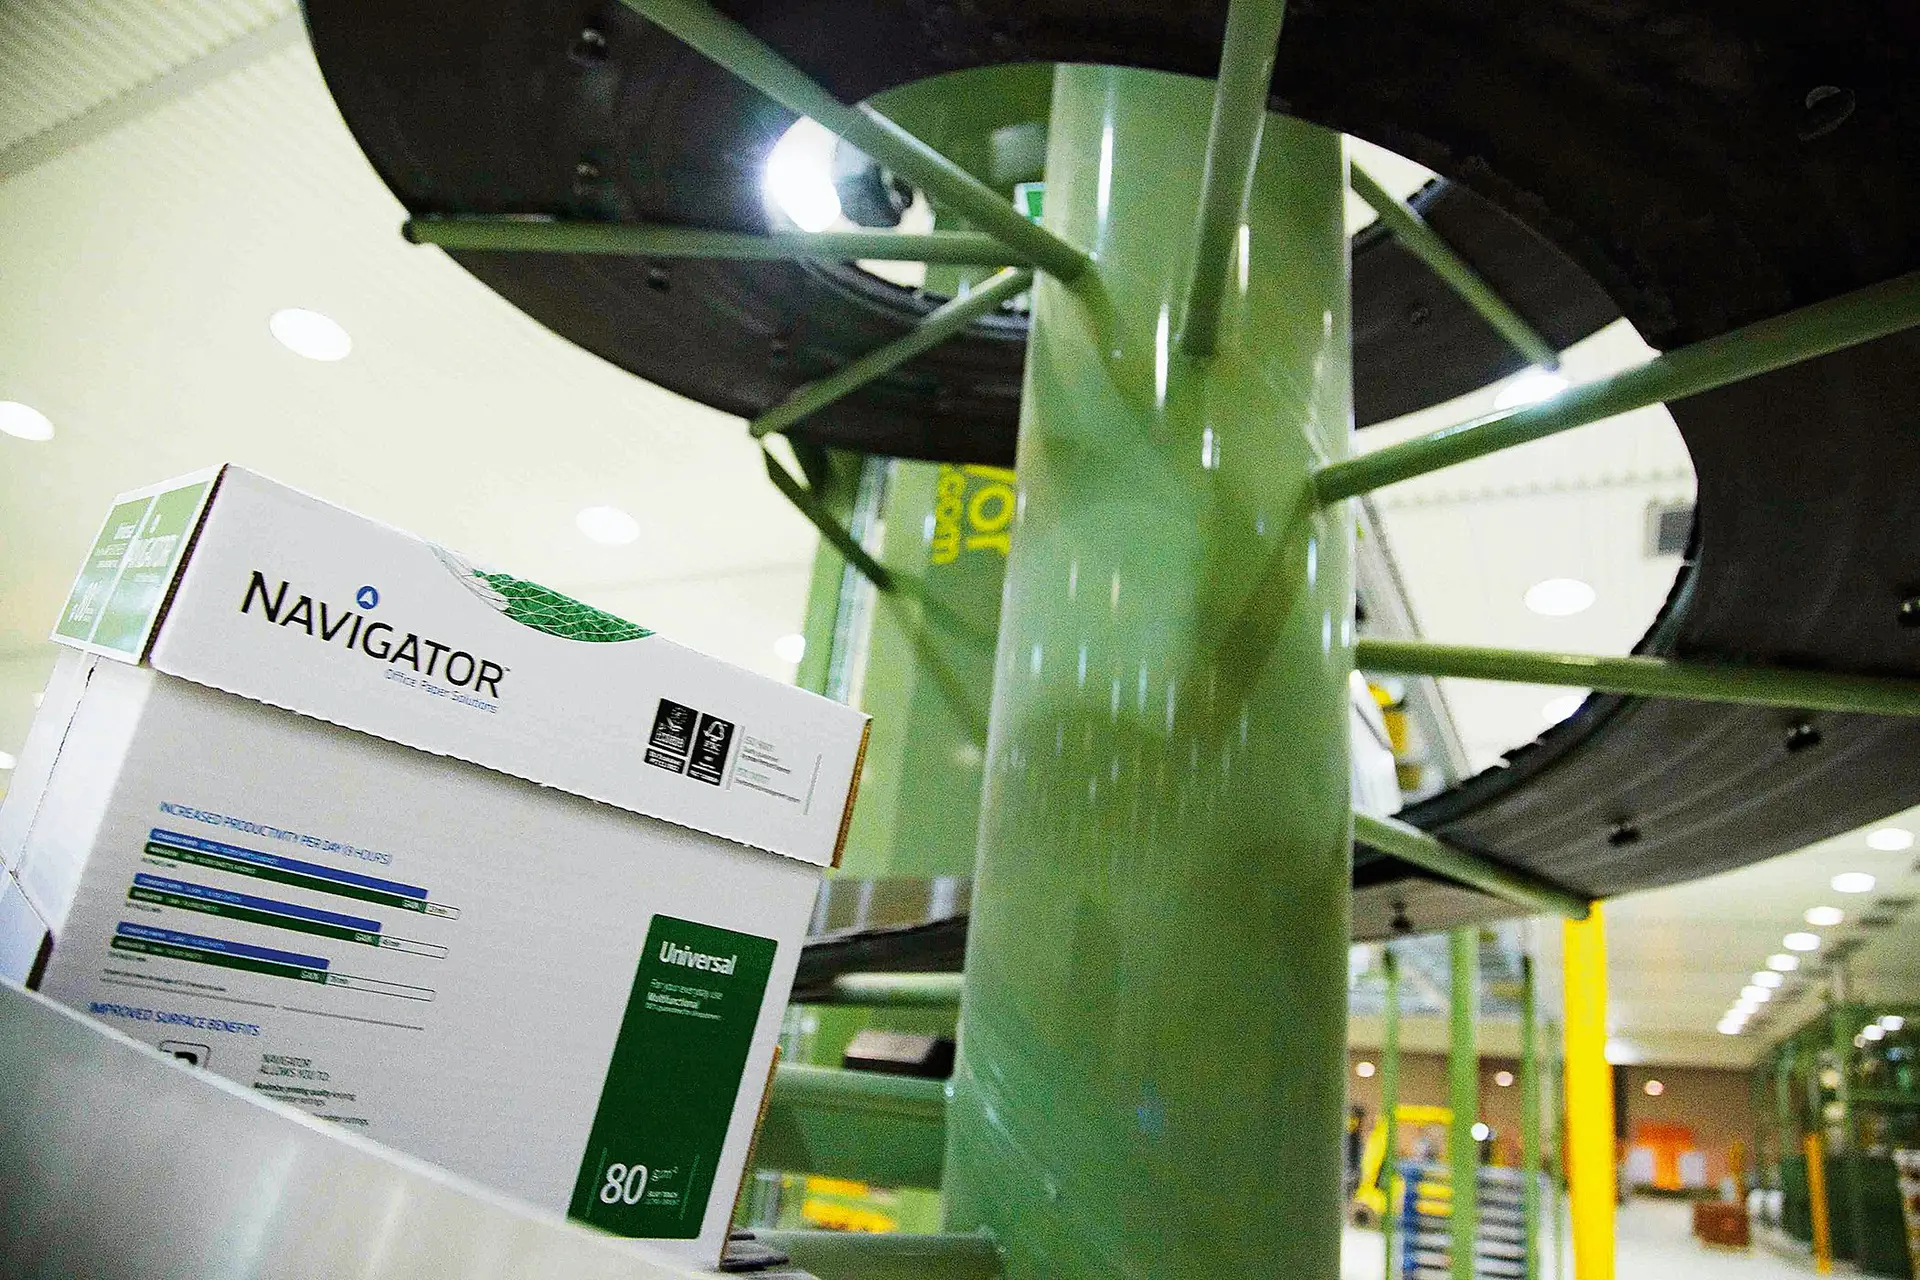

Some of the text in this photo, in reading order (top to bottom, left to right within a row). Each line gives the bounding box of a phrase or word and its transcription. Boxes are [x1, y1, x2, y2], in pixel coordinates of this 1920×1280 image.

[238, 569, 504, 699] NAVIGATOR
[385, 667, 417, 688] Office
[419, 679, 451, 698] Paper
[159, 800, 222, 825] INCREASED
[223, 815, 300, 843] PRODUCTIVITY
[301, 833, 322, 849] PER
[659, 940, 738, 976] Universal
[154, 1010, 205, 1030] SURFACE
[206, 1017, 261, 1037] BENEFITS
[600, 1163, 648, 1205] 80
